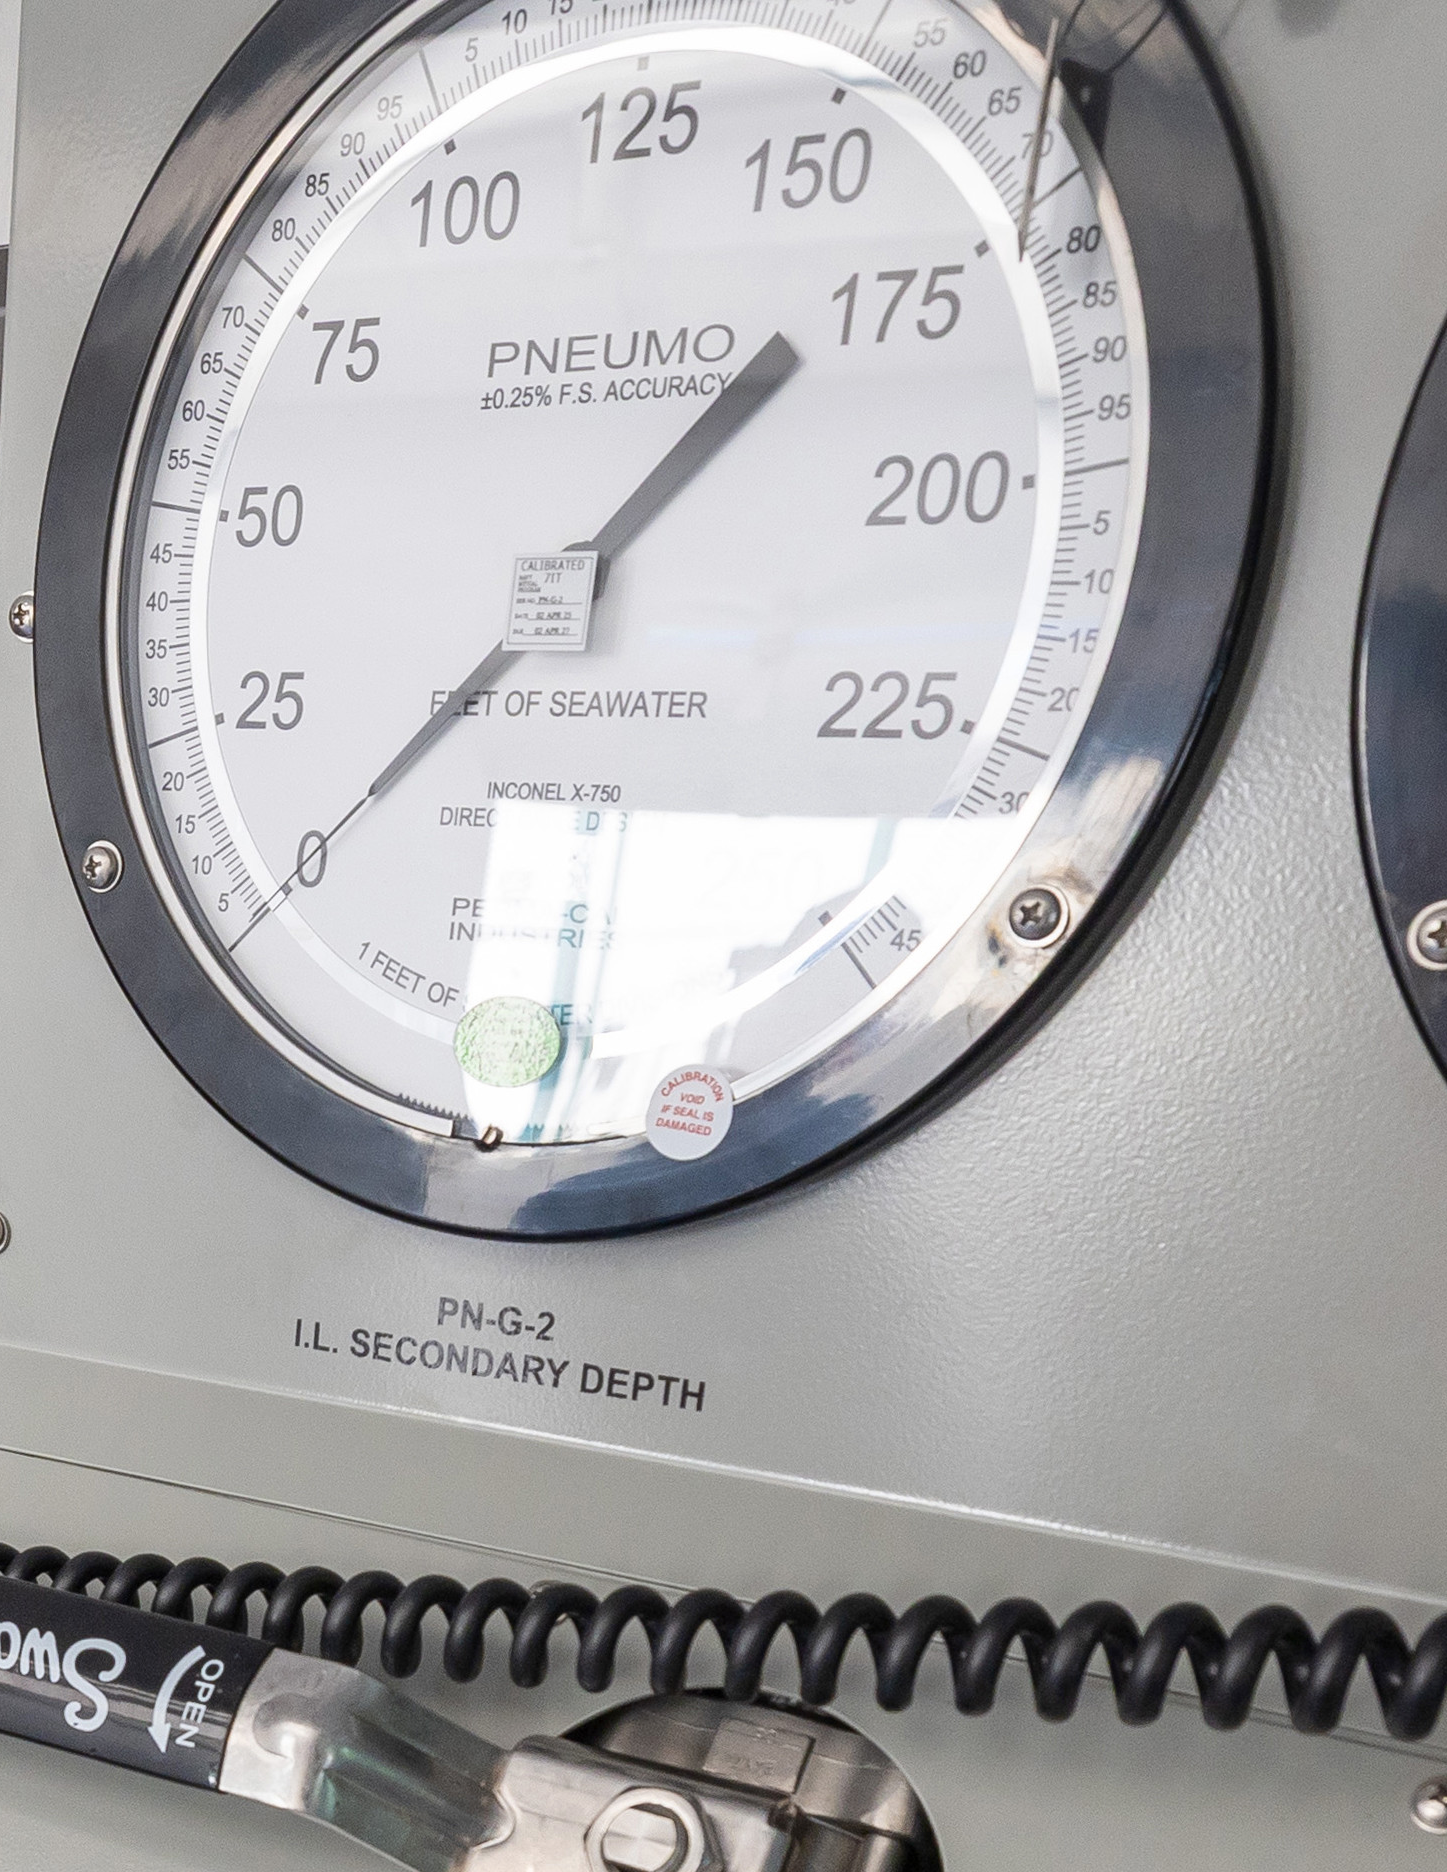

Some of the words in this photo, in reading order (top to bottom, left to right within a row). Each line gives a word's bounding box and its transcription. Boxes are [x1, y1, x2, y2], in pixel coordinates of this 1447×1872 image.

[503, 9, 528, 35] 10
[465, 38, 479, 62] 5
[953, 51, 987, 79] 60
[987, 88, 1023, 116] 65
[581, 80, 702, 164] 125
[340, 131, 366, 157] 90
[744, 128, 873, 212] 150
[305, 172, 331, 197] 85
[410, 171, 520, 248] 100
[272, 217, 297, 242] 80
[1067, 225, 1102, 254] 80
[831, 265, 964, 346] 175
[1082, 281, 1118, 308] 85
[221, 306, 246, 330] 70
[311, 317, 381, 385] 75
[487, 322, 735, 378] PNEUMO
[1093, 336, 1128, 362] 90
[200, 352, 224, 375] 65
[480, 384, 553, 411] ±0.25%
[558, 381, 597, 405] F.S.
[603, 371, 733, 402] ACCURACY
[182, 400, 205, 422] 60
[1099, 395, 1132, 421] 95
[167, 450, 192, 471] 55
[866, 450, 1010, 527] 200
[235, 485, 304, 547] 50
[1092, 511, 1111, 536] 5
[150, 544, 175, 565] 45
[521, 559, 586, 571] CALIBRATED
[1085, 569, 1114, 595] 10
[146, 592, 169, 613] 40
[145, 639, 169, 660] 35
[1069, 628, 1099, 655] 15
[148, 687, 170, 709] 30
[235, 671, 305, 730] 25
[504, 691, 542, 718] OF
[550, 690, 707, 718] SEAWATER
[817, 671, 957, 739] 225
[161, 771, 185, 793] 20
[486, 782, 566, 802] INCONEL
[571, 783, 622, 804] X-750
[175, 814, 196, 835] 15
[191, 855, 213, 876] 10
[297, 830, 328, 887] 0
[217, 893, 230, 913] 5
[371, 946, 426, 995] FEET
[427, 979, 460, 1009] OF
[660, 1071, 724, 1102] CALIBRATION
[680, 1092, 705, 1105] VOID
[673, 1106, 700, 1119] SEAL
[655, 1117, 712, 1136] DAMAGED
[437, 1296, 556, 1342] PN-G-2
[294, 1318, 339, 1354] I.L.
[350, 1328, 570, 1389] SECONDARY
[580, 1363, 706, 1412] DEPTH
[176, 1657, 225, 1749] OPEN
